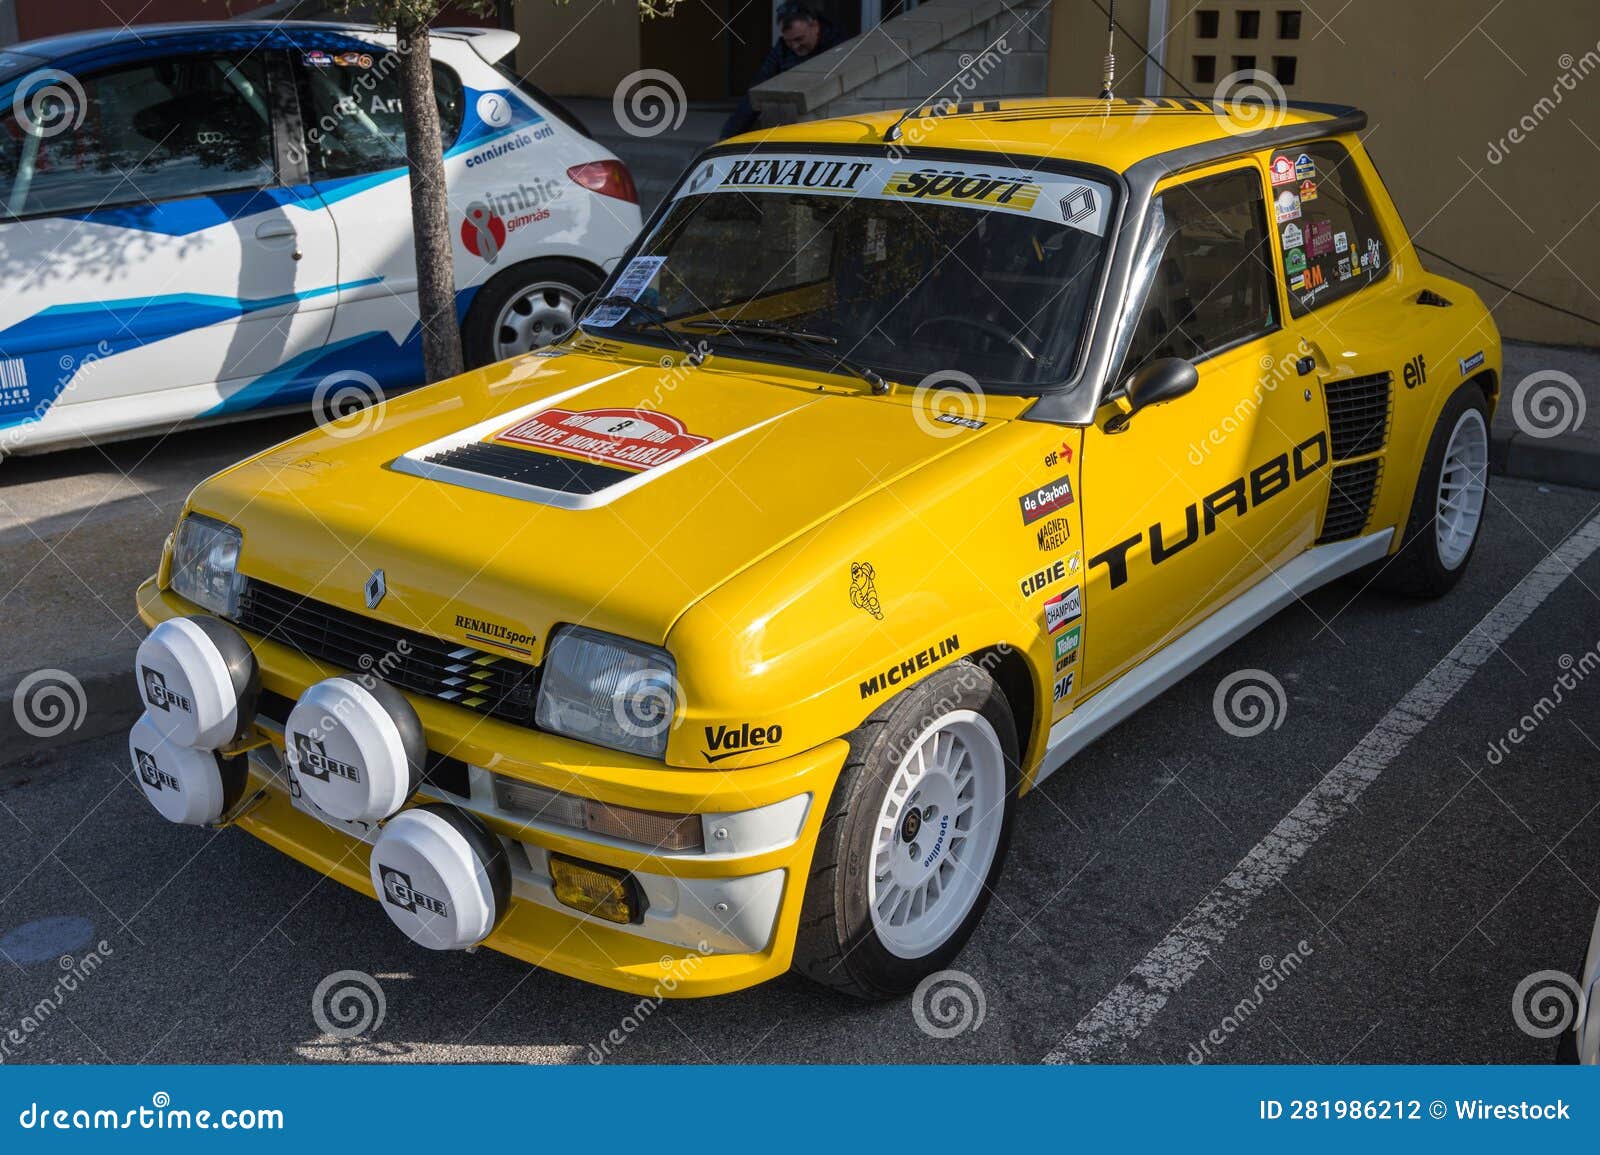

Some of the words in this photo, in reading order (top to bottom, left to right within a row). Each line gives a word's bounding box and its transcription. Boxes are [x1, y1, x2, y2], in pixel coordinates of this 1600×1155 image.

[720, 159, 873, 190] RENAULT
[897, 168, 1034, 204] sport
[1403, 354, 1426, 390] elf
[512, 420, 565, 441] RALLYE
[1044, 451, 1058, 468] elf
[1024, 496, 1037, 511] de
[1037, 482, 1070, 506] Carbon
[1088, 430, 1328, 590] TURBO
[1046, 597, 1080, 625] CHAMPION
[1057, 634, 1079, 656] Valeo
[859, 634, 961, 700] MICHELIN
[705, 723, 783, 752] Valeo
[924, 815, 949, 868] speedline
